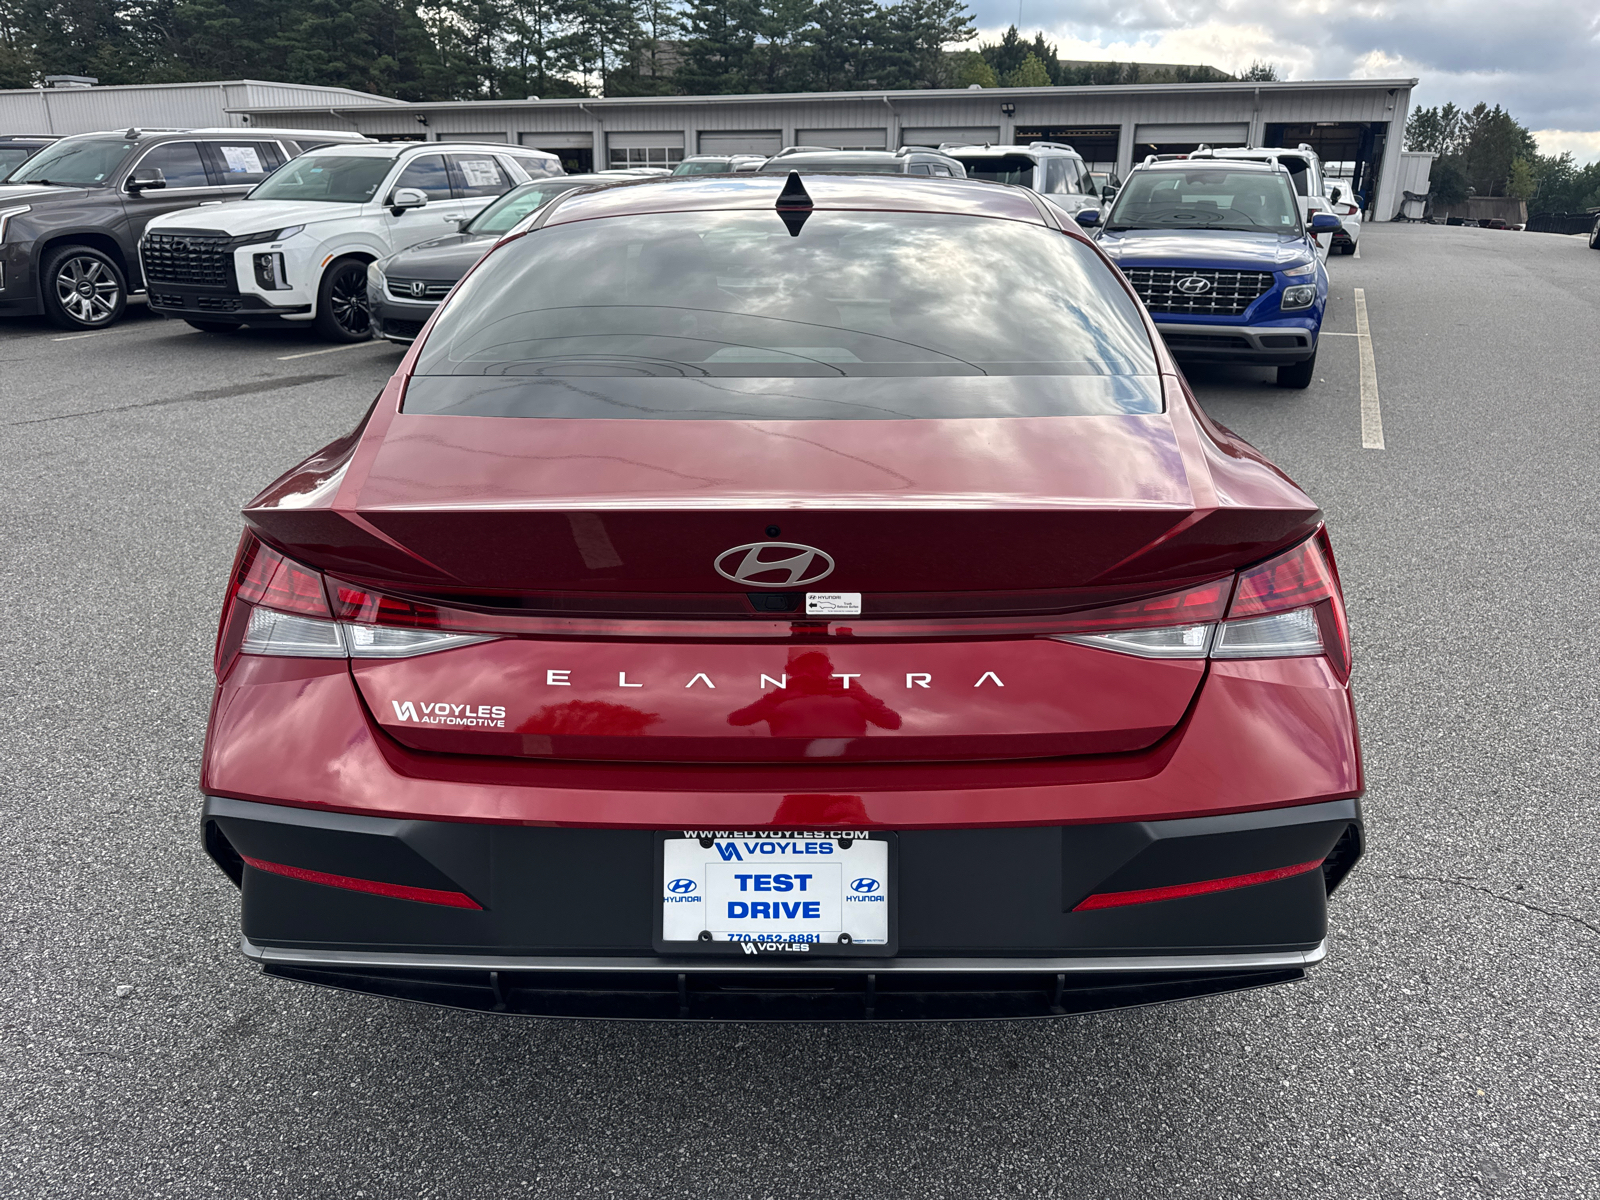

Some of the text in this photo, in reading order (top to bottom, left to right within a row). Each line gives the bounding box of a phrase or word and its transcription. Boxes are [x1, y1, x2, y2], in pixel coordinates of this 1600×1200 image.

[546, 669, 1005, 689] ELANTRA
[420, 702, 506, 719] VOYLES
[421, 715, 506, 728] AUTOMOTIVE
[683, 830, 869, 840] WWW.EDVOYLES.COM
[744, 842, 834, 855] VOYLES
[734, 874, 813, 892] TEST
[664, 895, 702, 903] HYUNDAI
[727, 901, 821, 919] DRIVE
[727, 933, 821, 943] 770-952-8881
[758, 943, 810, 952] VOYLES
